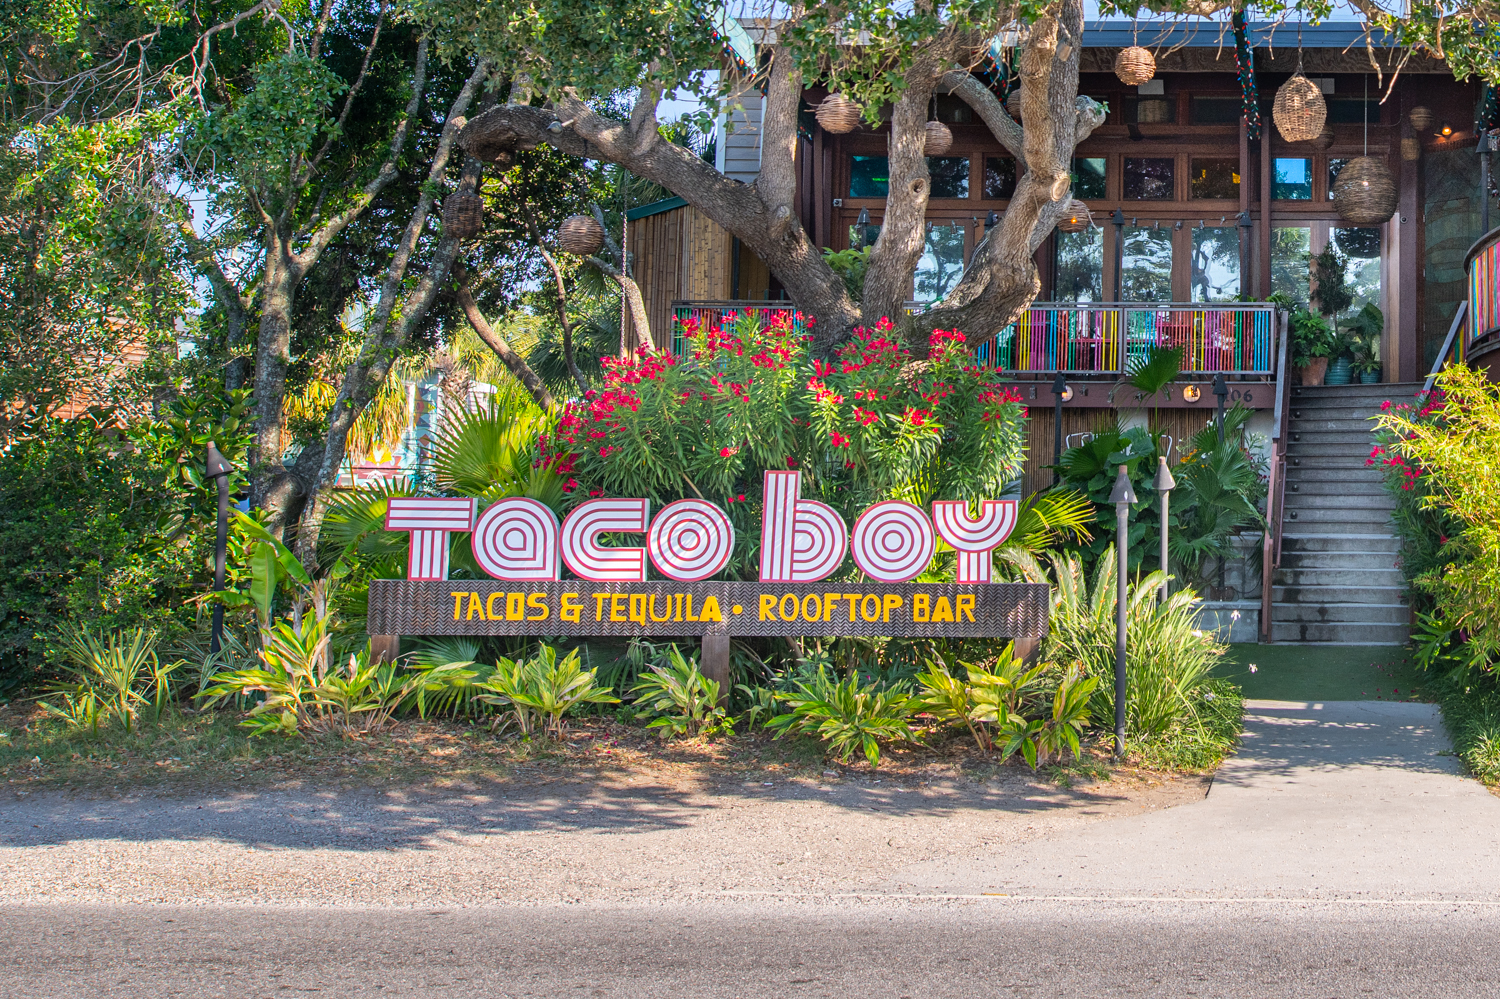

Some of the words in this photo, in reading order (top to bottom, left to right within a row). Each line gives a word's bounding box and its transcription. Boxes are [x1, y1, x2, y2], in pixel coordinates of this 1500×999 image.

[451, 592, 549, 621] TACOS
[559, 592, 584, 624] &
[592, 592, 722, 626] TEQUILA
[758, 592, 903, 622] ROOFTOP
[913, 593, 976, 622] BAR
